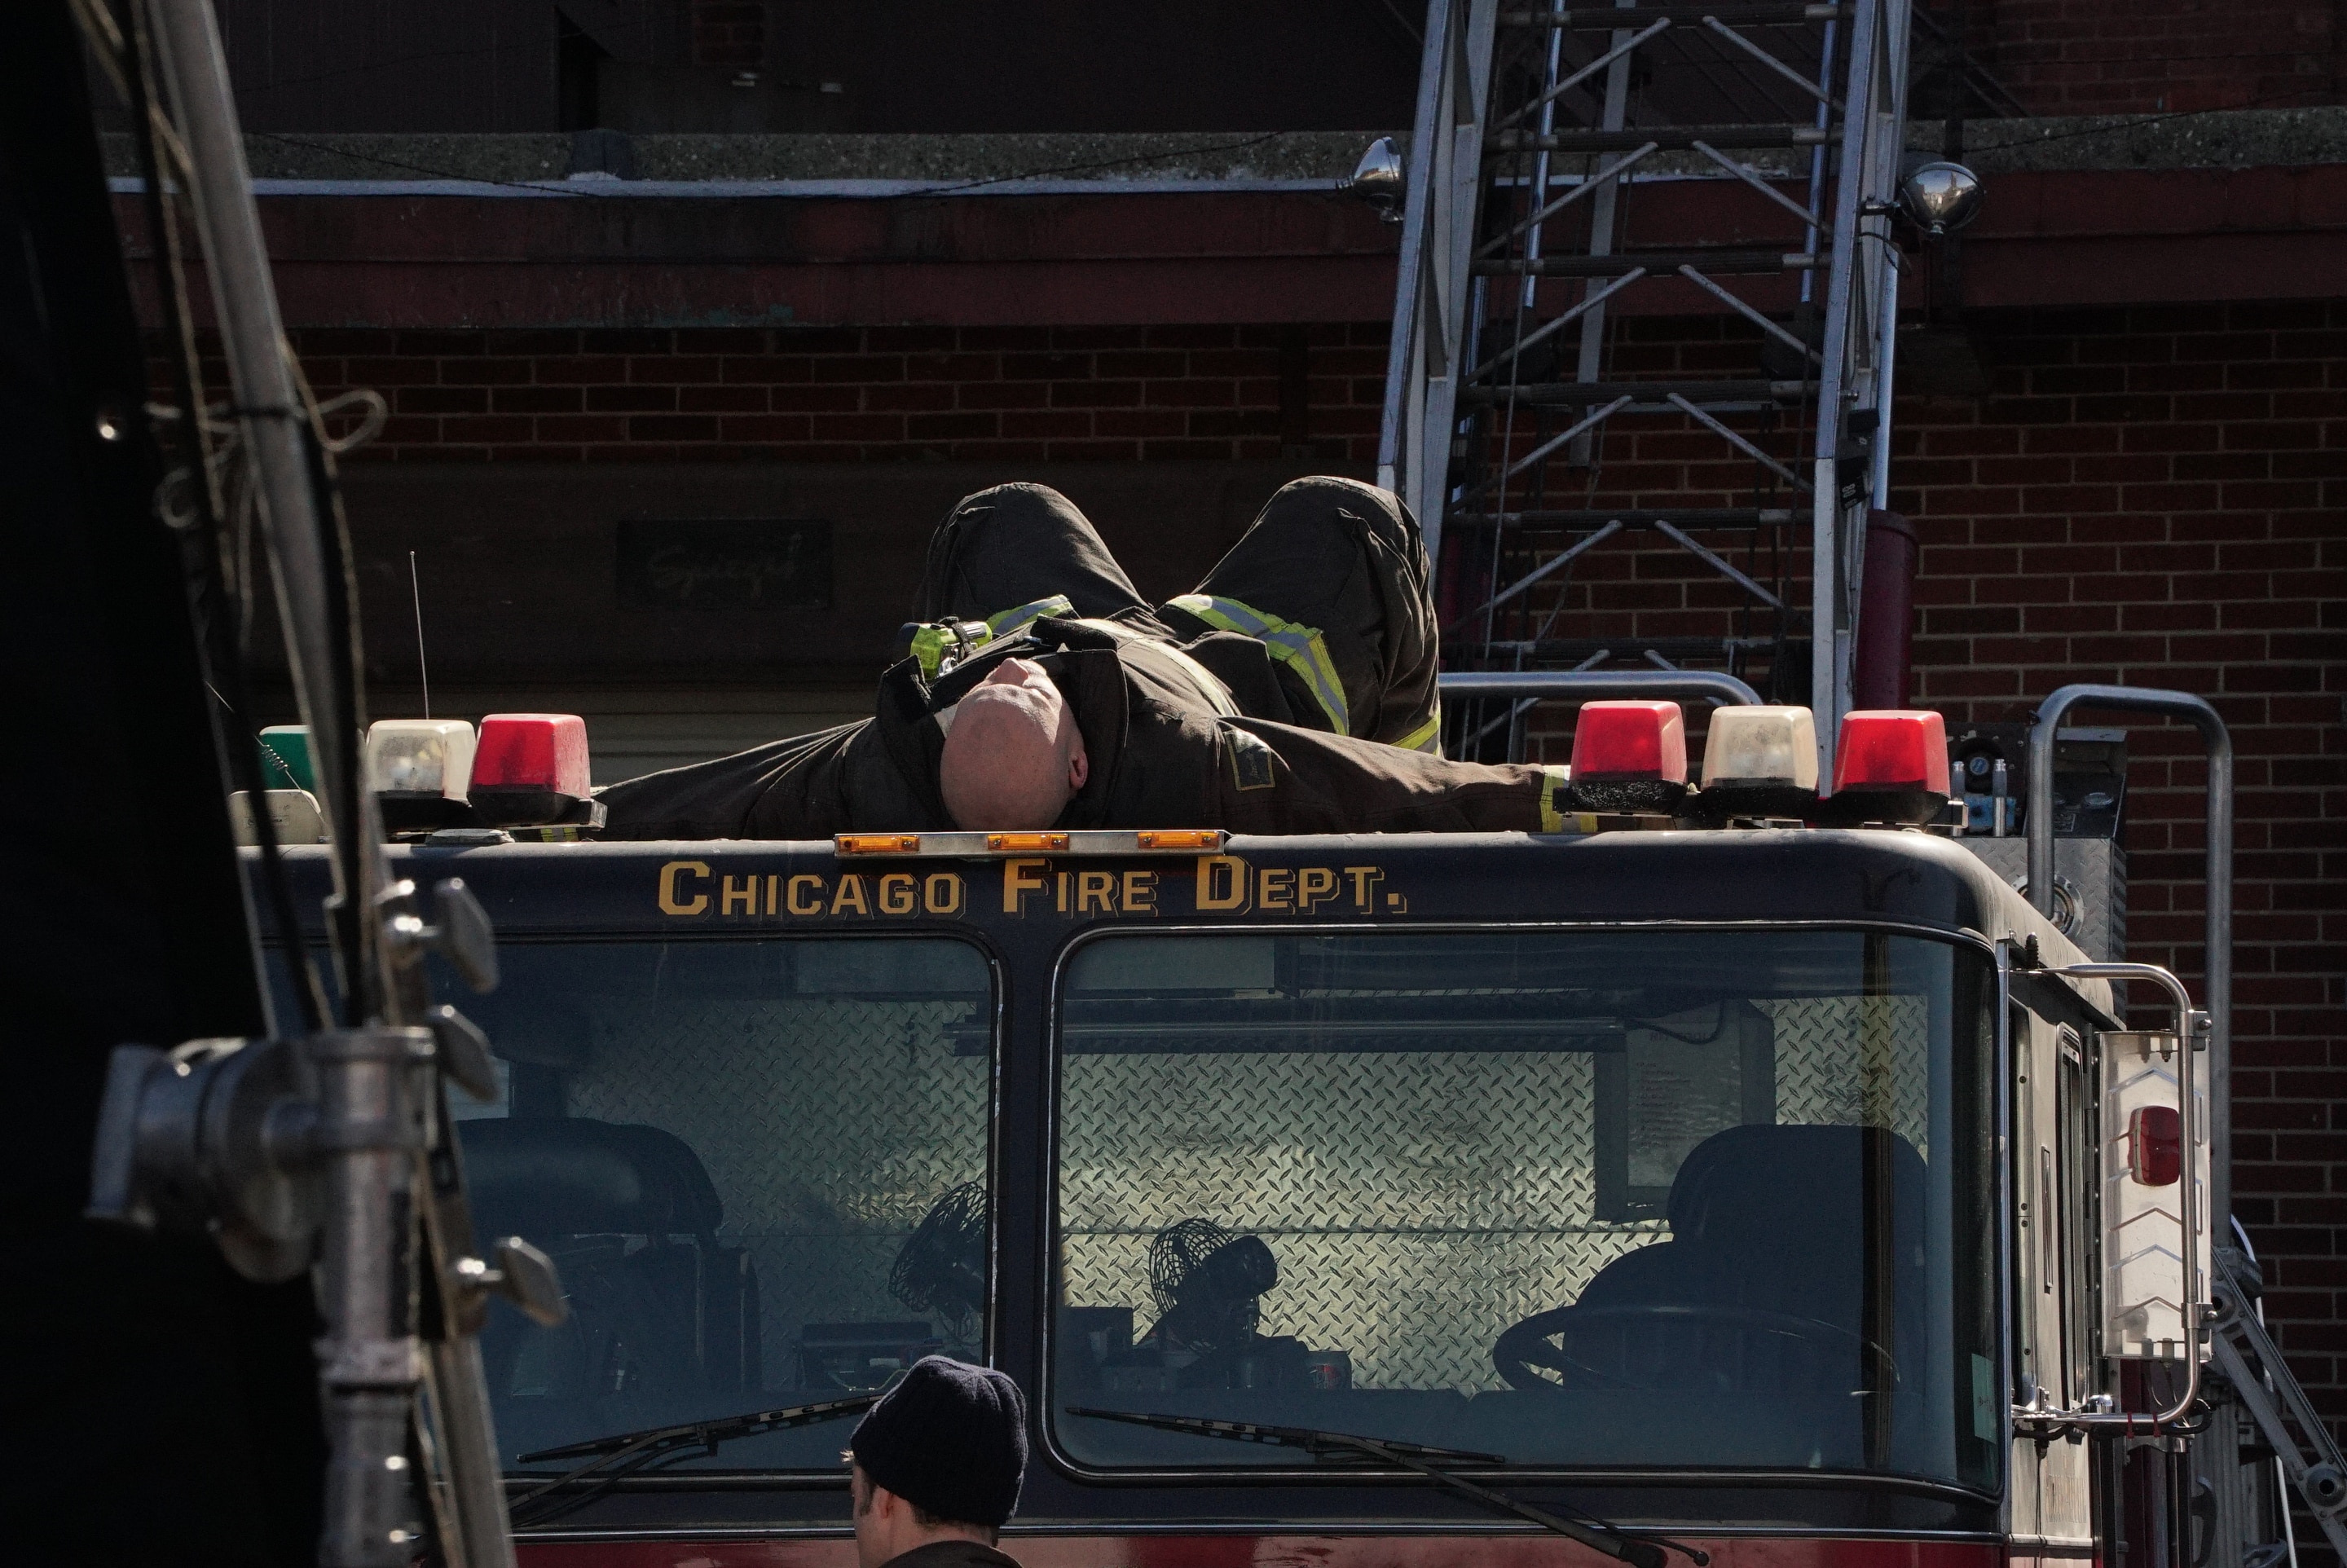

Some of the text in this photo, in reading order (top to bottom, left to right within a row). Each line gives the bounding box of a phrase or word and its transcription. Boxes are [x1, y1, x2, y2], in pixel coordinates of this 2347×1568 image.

[658, 856, 1407, 918] CHICAGO FIRE DEPT.
